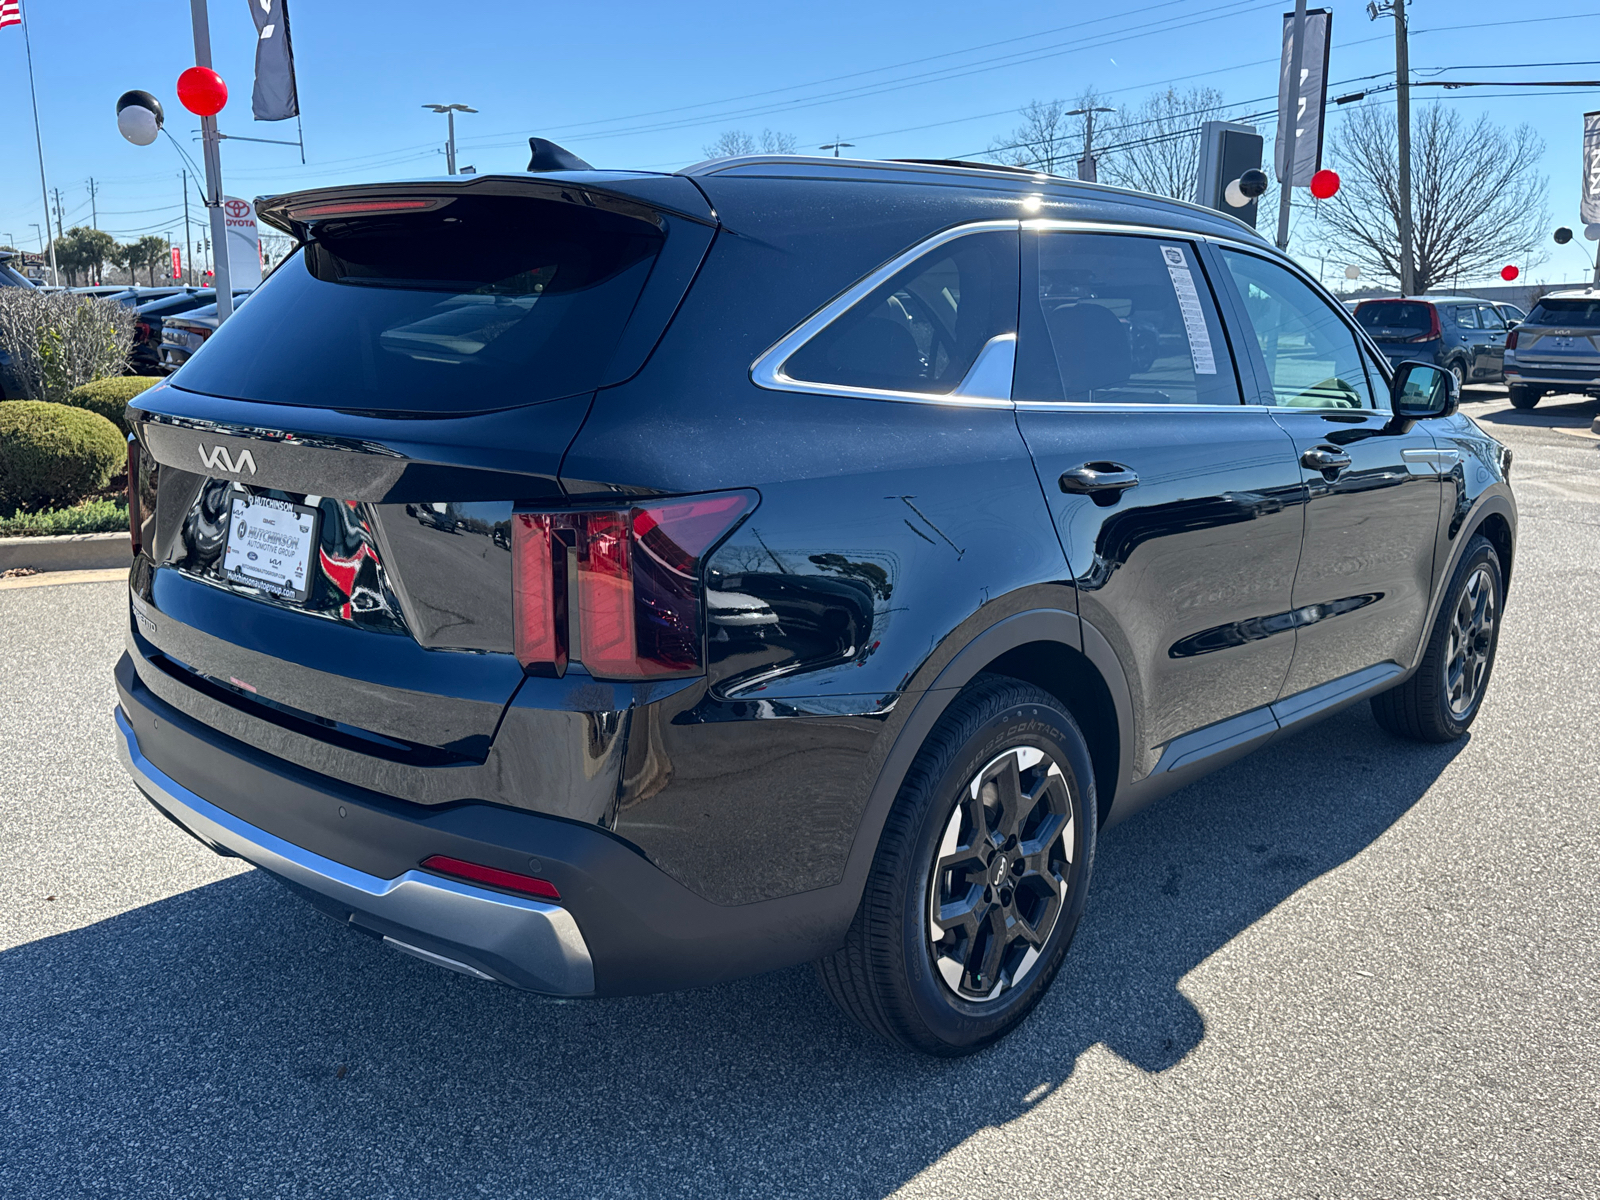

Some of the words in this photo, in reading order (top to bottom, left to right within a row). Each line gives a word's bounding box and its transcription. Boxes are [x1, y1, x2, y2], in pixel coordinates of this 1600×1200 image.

[225, 219, 255, 227] OYOTA
[198, 442, 257, 476] KIA
[255, 495, 294, 513] HUTCHINSON
[247, 526, 299, 550] HUTCHINSON
[247, 540, 278, 554] AUTOMOTIVE
[278, 546, 296, 558] GROUP
